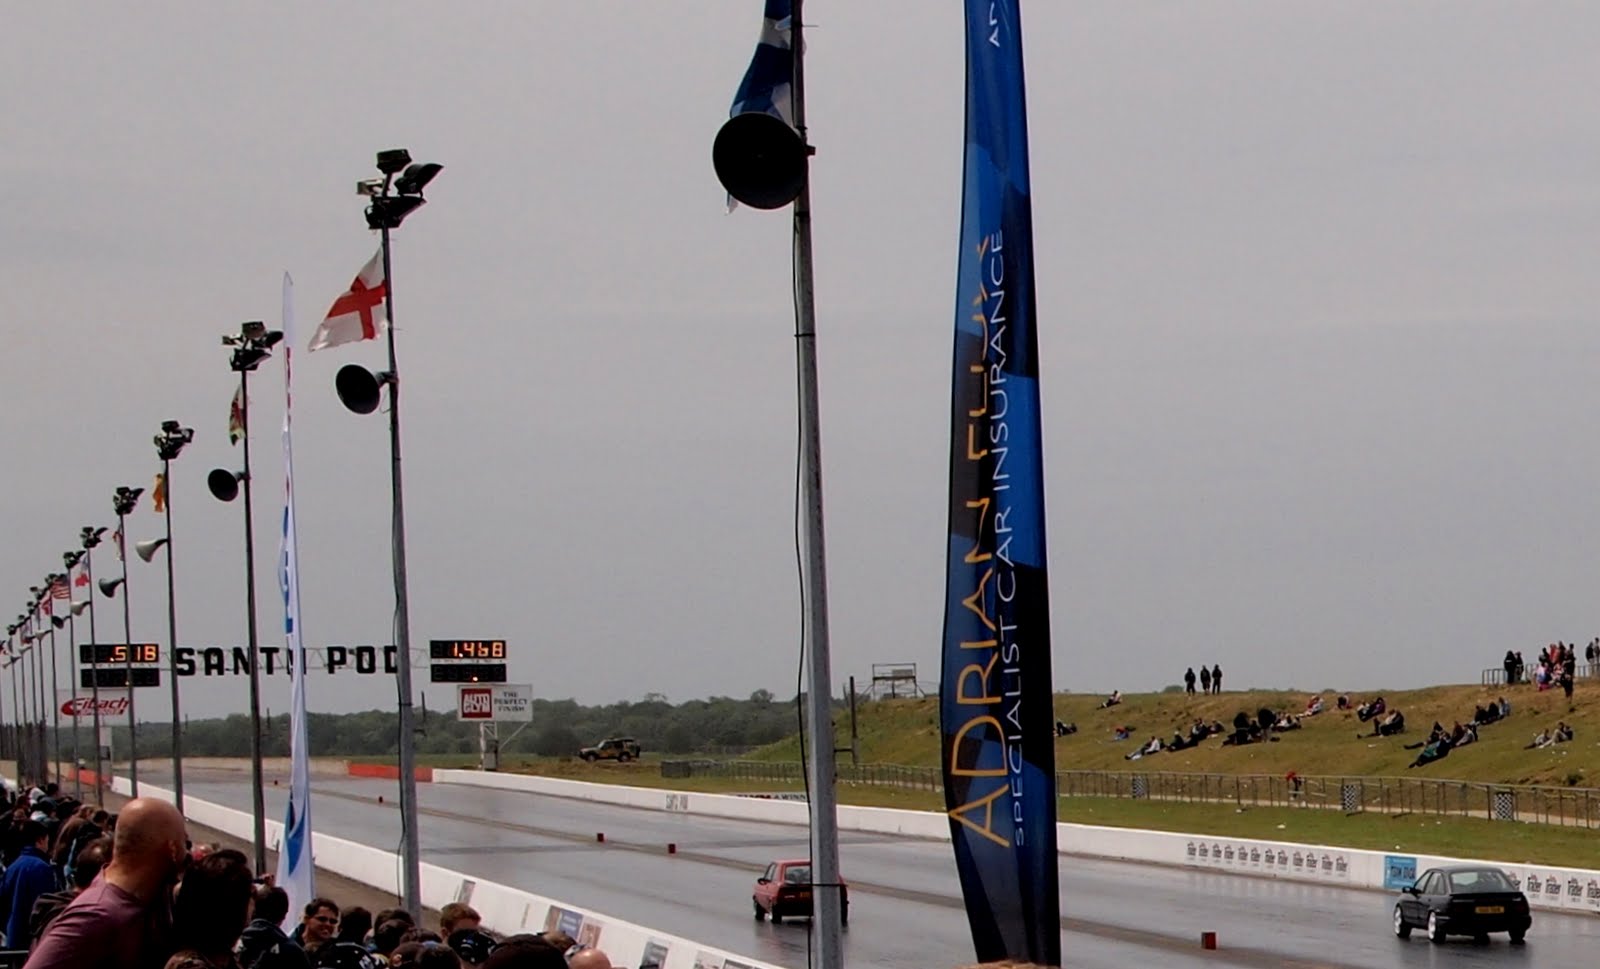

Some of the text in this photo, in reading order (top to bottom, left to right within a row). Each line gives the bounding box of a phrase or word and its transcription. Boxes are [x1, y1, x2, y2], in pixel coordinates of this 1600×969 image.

[990, 229, 1024, 847] SPECIALIST CAR INSURANCE
[176, 646, 307, 676] SANT
[453, 641, 504, 658] 1.468
[948, 498, 1009, 847] ADRIAN
